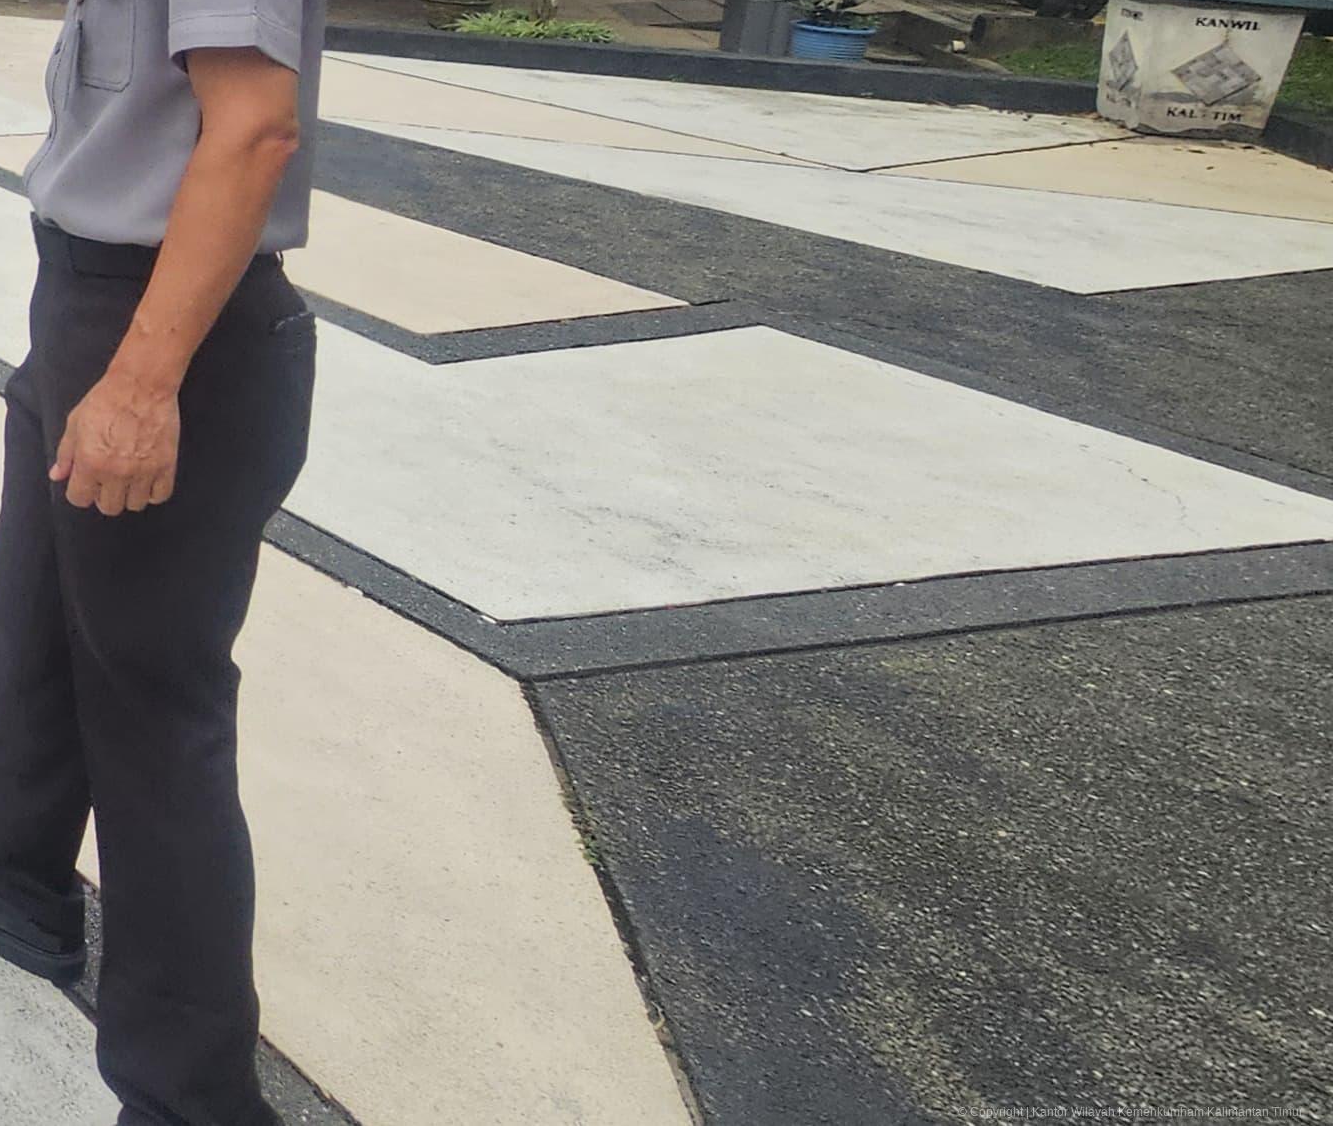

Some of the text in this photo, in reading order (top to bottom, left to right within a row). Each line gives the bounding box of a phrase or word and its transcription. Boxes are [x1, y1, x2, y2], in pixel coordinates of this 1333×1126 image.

[1195, 16, 1261, 31] KANWIL
[1166, 106, 1198, 120] KAL
[1213, 110, 1243, 123] TIM
